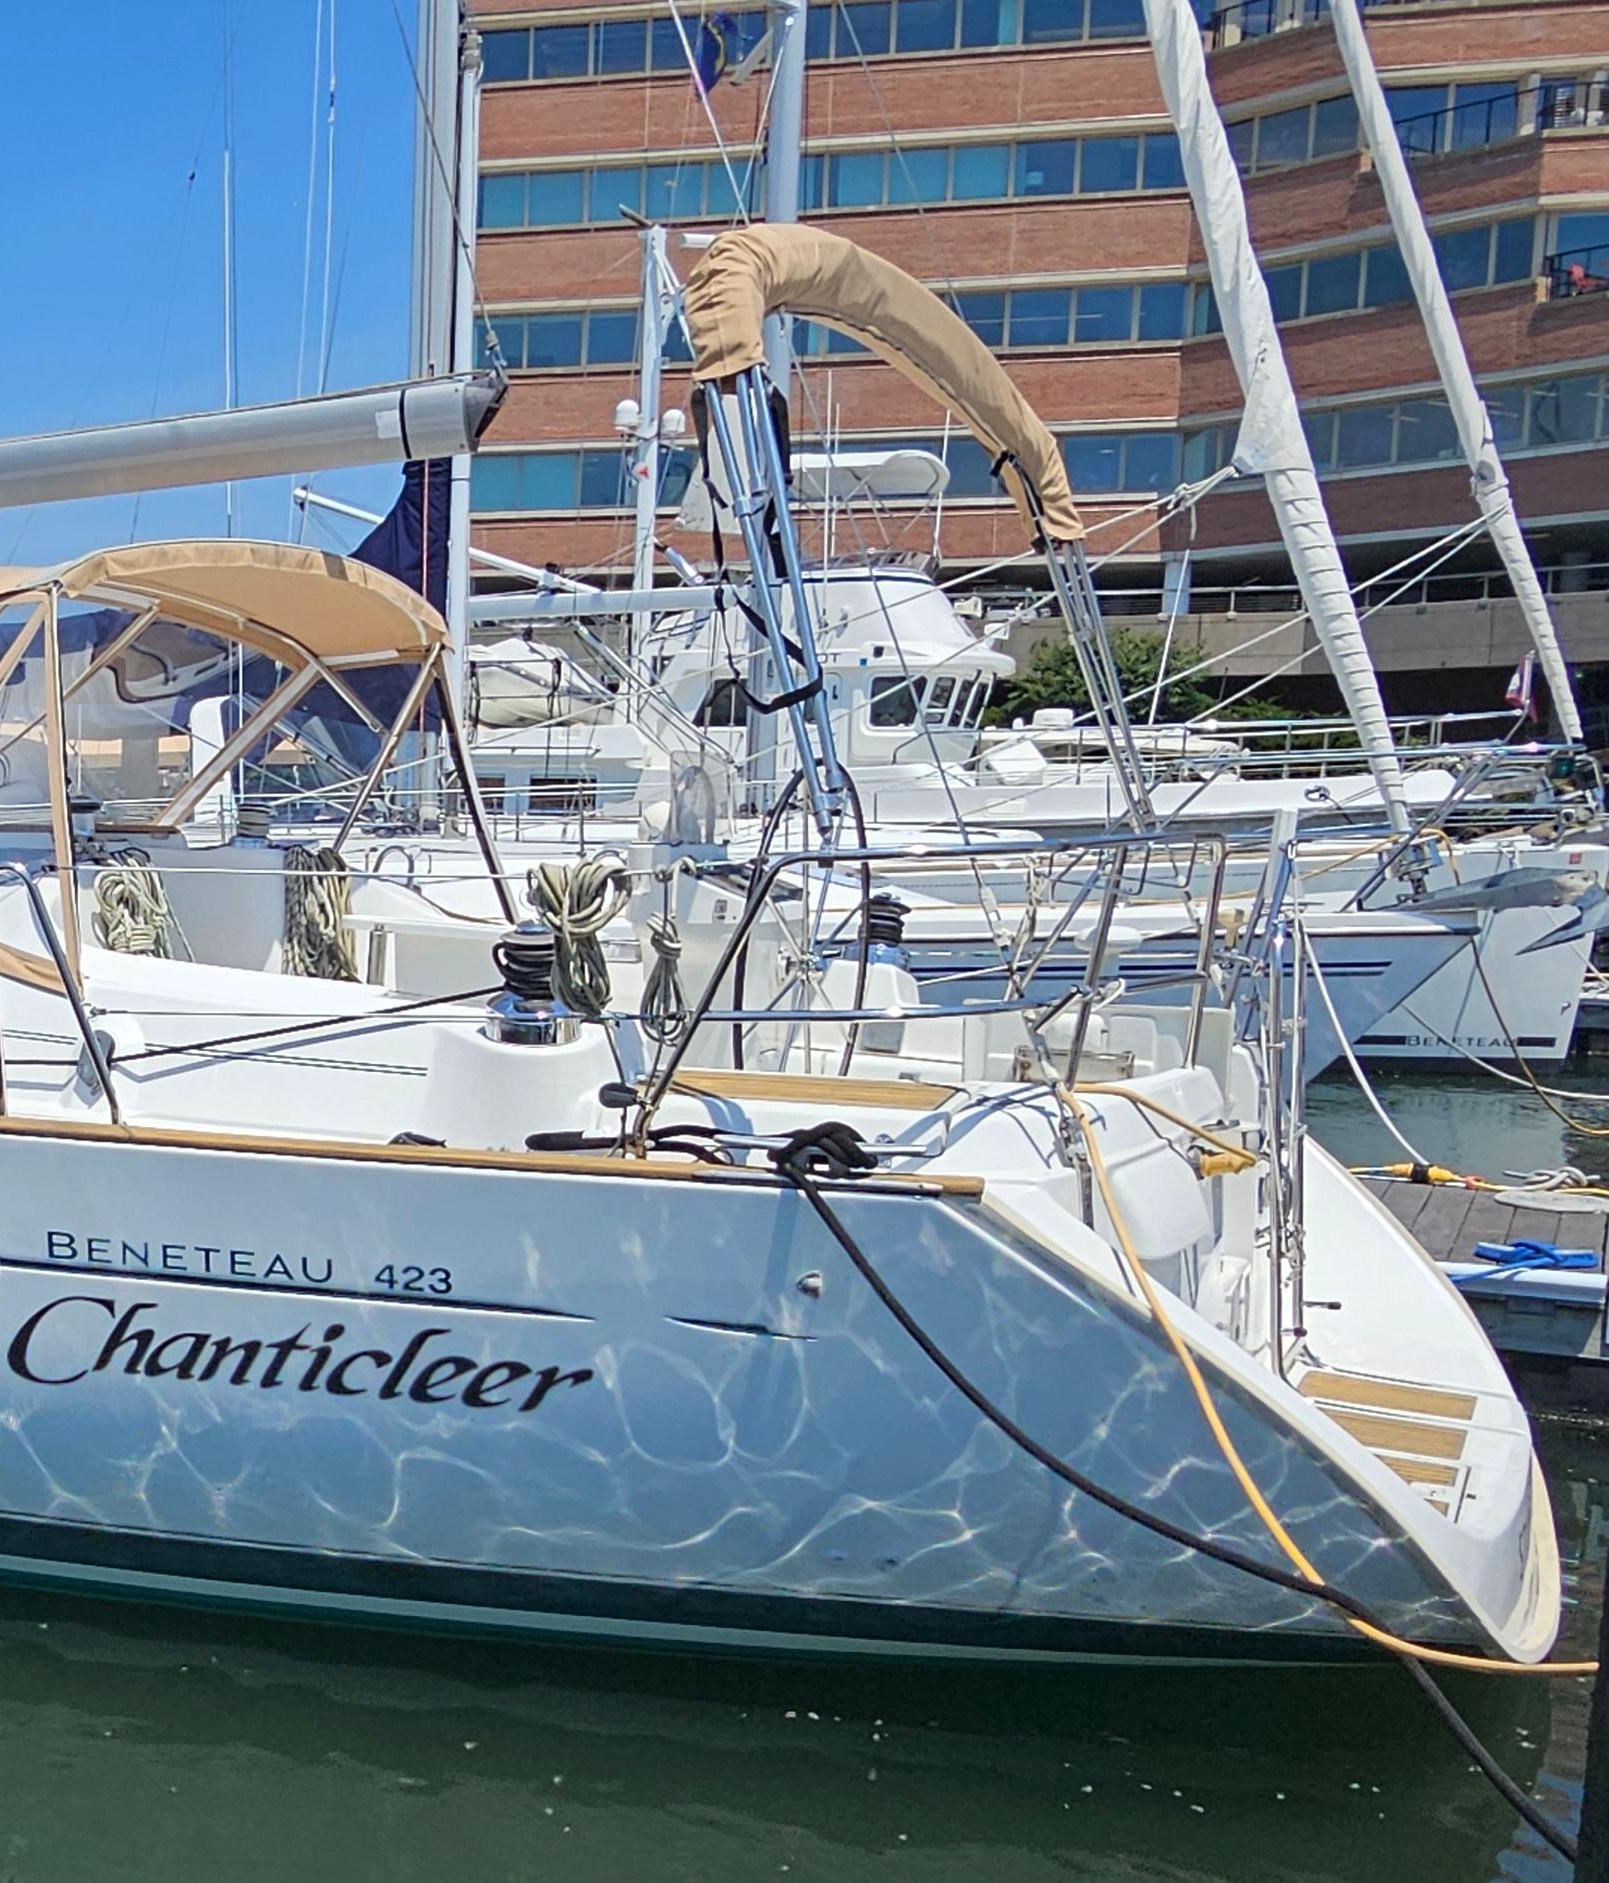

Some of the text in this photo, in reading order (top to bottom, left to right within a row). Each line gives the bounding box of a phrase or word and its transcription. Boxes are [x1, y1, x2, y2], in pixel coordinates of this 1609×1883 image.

[46, 1230, 453, 1295] BENETEAU 423
[5, 1296, 594, 1413] Chanticleer
